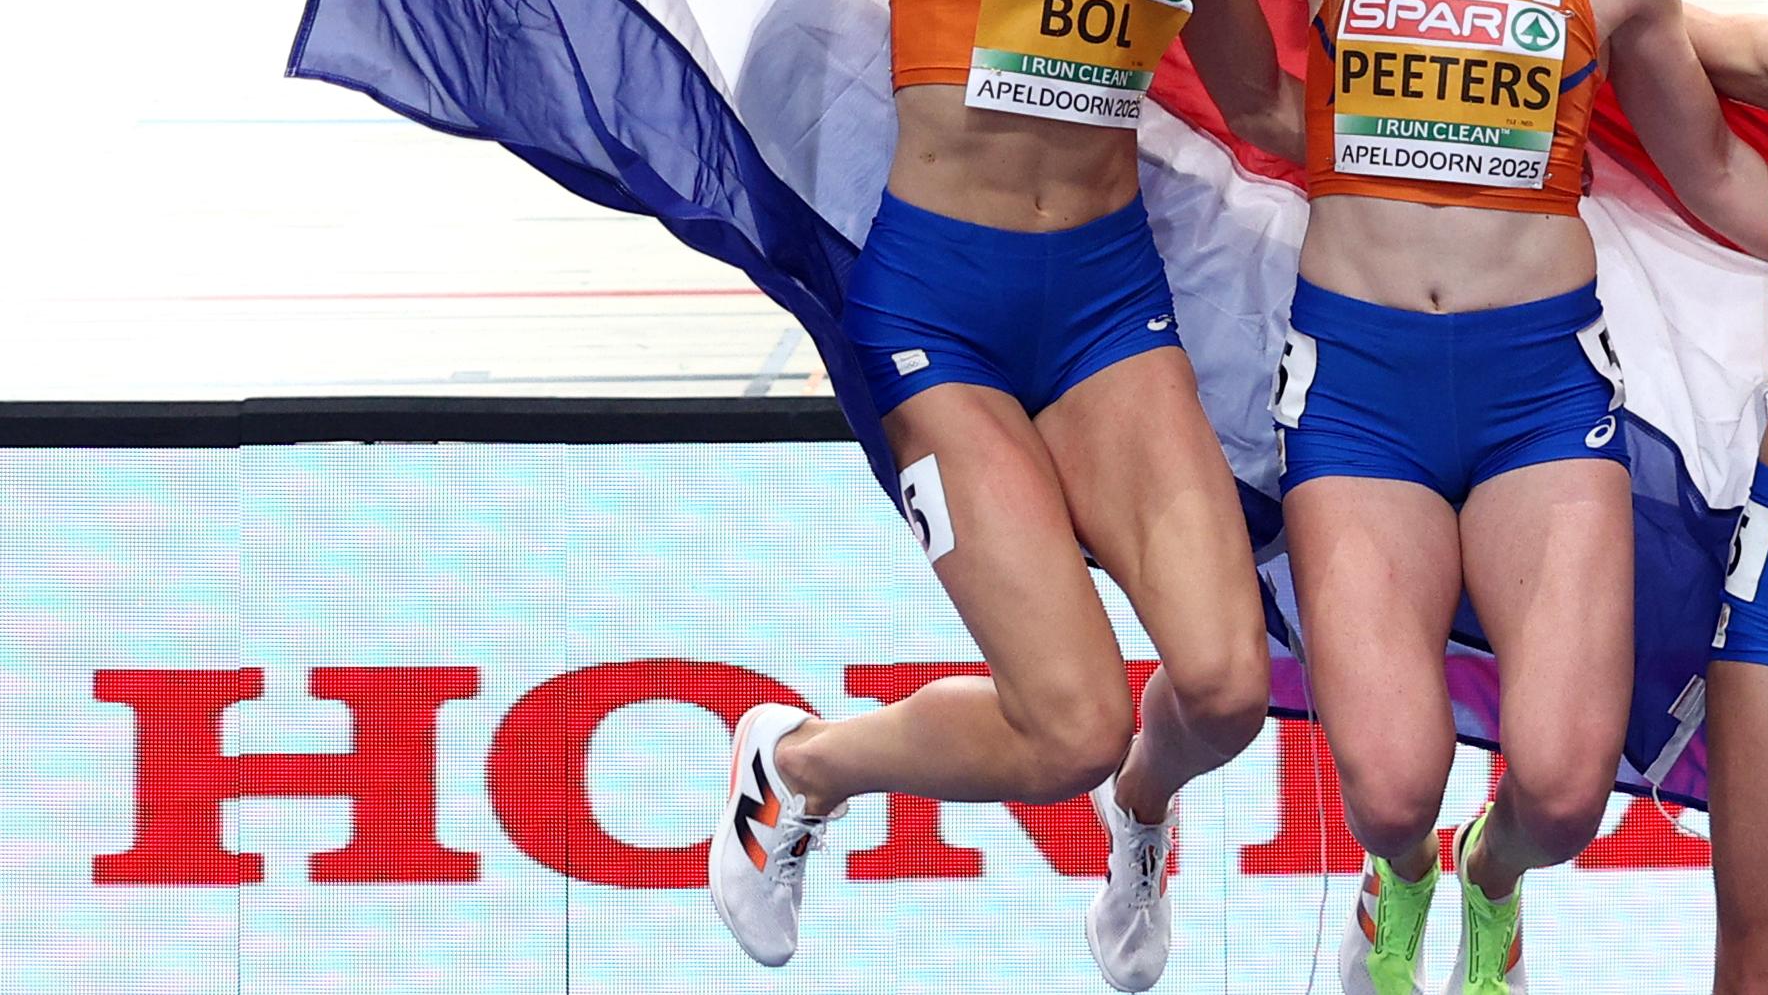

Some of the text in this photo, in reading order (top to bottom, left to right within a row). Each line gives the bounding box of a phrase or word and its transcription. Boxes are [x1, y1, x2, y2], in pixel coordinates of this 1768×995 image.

[1032, 57, 1076, 79] RUN
[1341, 50, 1551, 111] PEETERS
[976, 79, 1115, 117] APELDOORN
[1376, 118, 1383, 135] I
[1386, 119, 1430, 137] RUN
[1341, 145, 1542, 179] APELDOORN 2025
